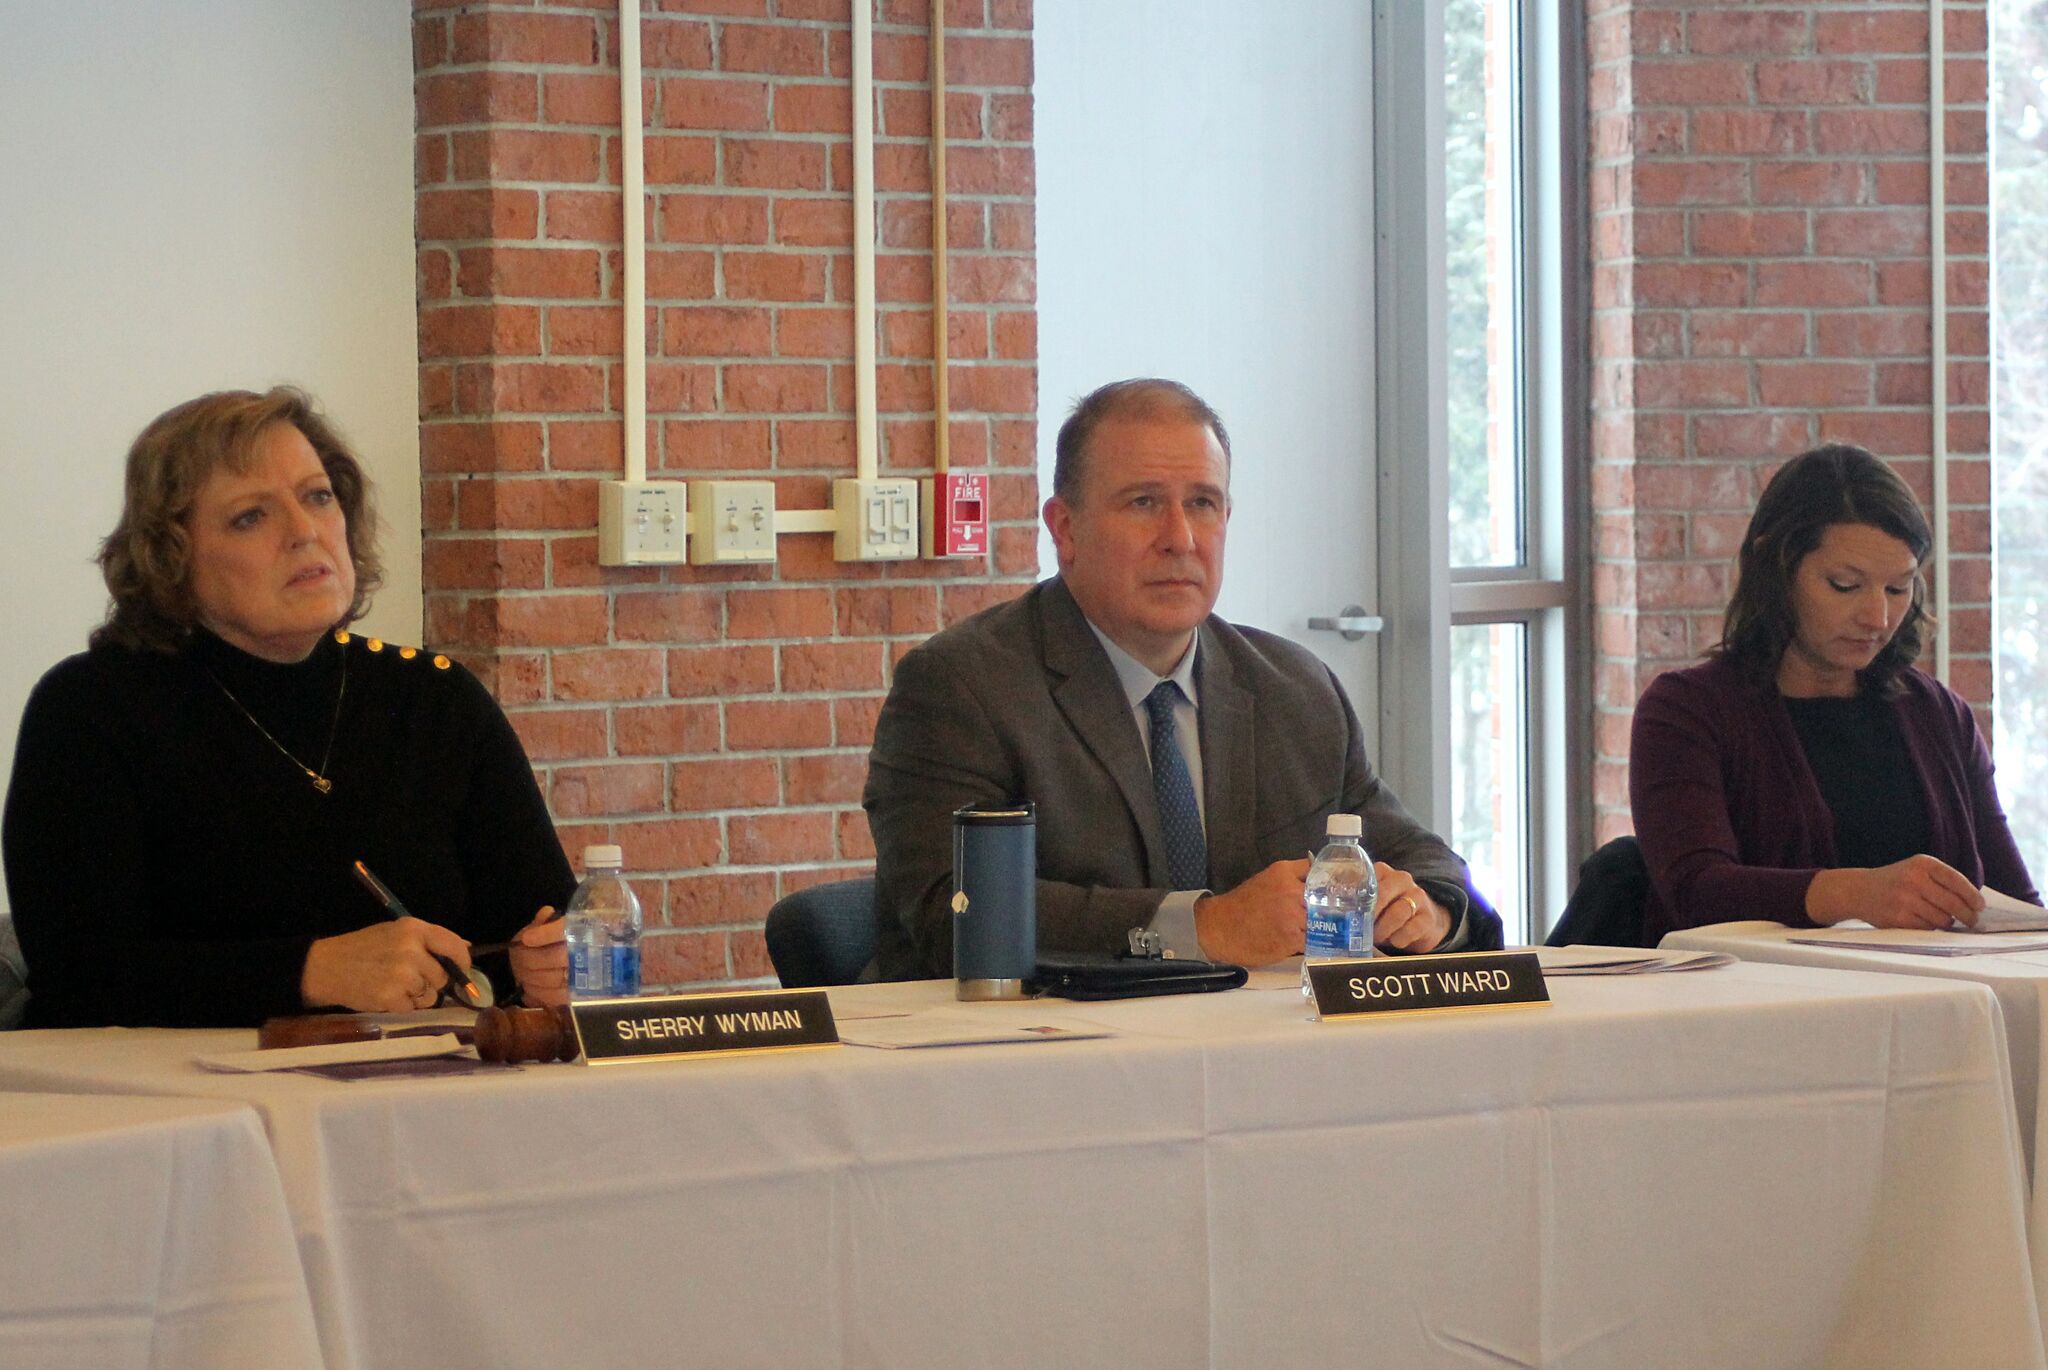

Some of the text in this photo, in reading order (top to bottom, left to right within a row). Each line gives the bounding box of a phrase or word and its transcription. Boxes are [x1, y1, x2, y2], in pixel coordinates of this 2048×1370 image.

[955, 487, 981, 498] FIRE
[1348, 969, 1511, 1000] SCOTT WARD
[616, 1009, 802, 1040] SHERRY WYMAN
